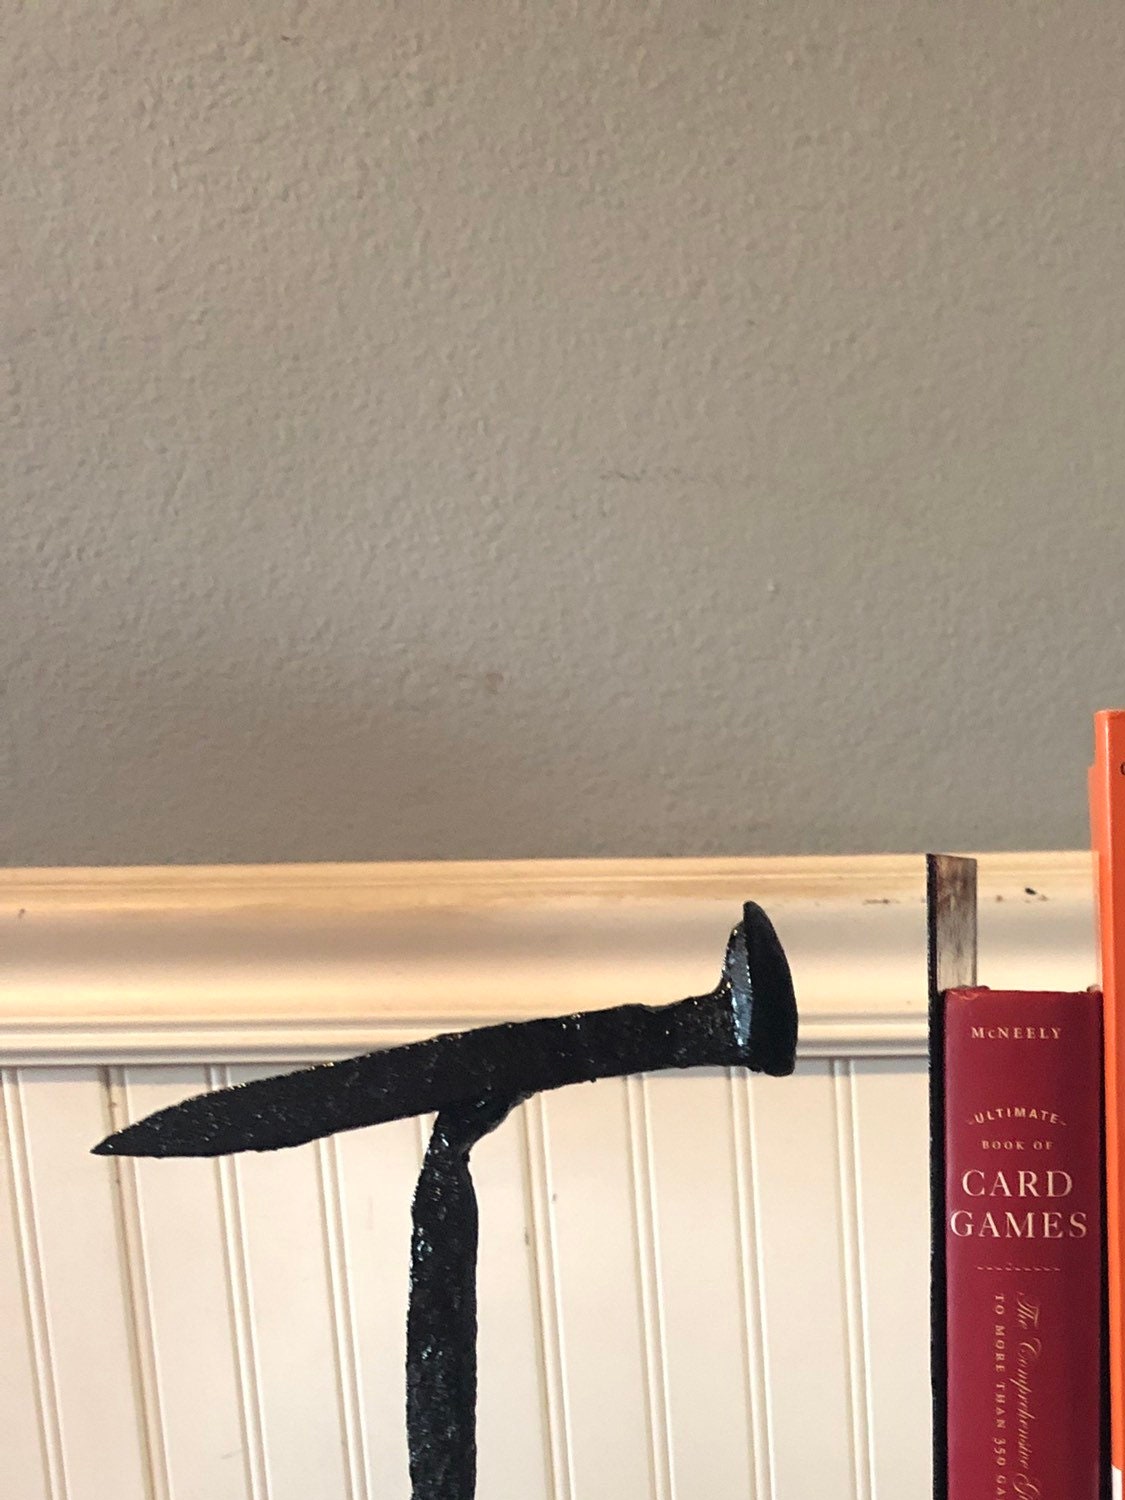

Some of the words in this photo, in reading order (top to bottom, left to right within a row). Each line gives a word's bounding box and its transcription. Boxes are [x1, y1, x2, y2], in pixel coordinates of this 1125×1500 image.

[971, 1026, 1062, 1040] McNEELY
[973, 1107, 1060, 1125] ULTIMATE
[982, 1139, 1025, 1151] BOOK
[1033, 1139, 1054, 1151] OF
[961, 1169, 1073, 1198] CARD
[950, 1210, 1088, 1239] GAMES
[994, 1293, 1005, 1316] TO
[1017, 1291, 1040, 1330] The
[994, 1324, 1006, 1374] MORE
[994, 1381, 1006, 1430] THAN
[992, 1437, 1007, 1467] 350
